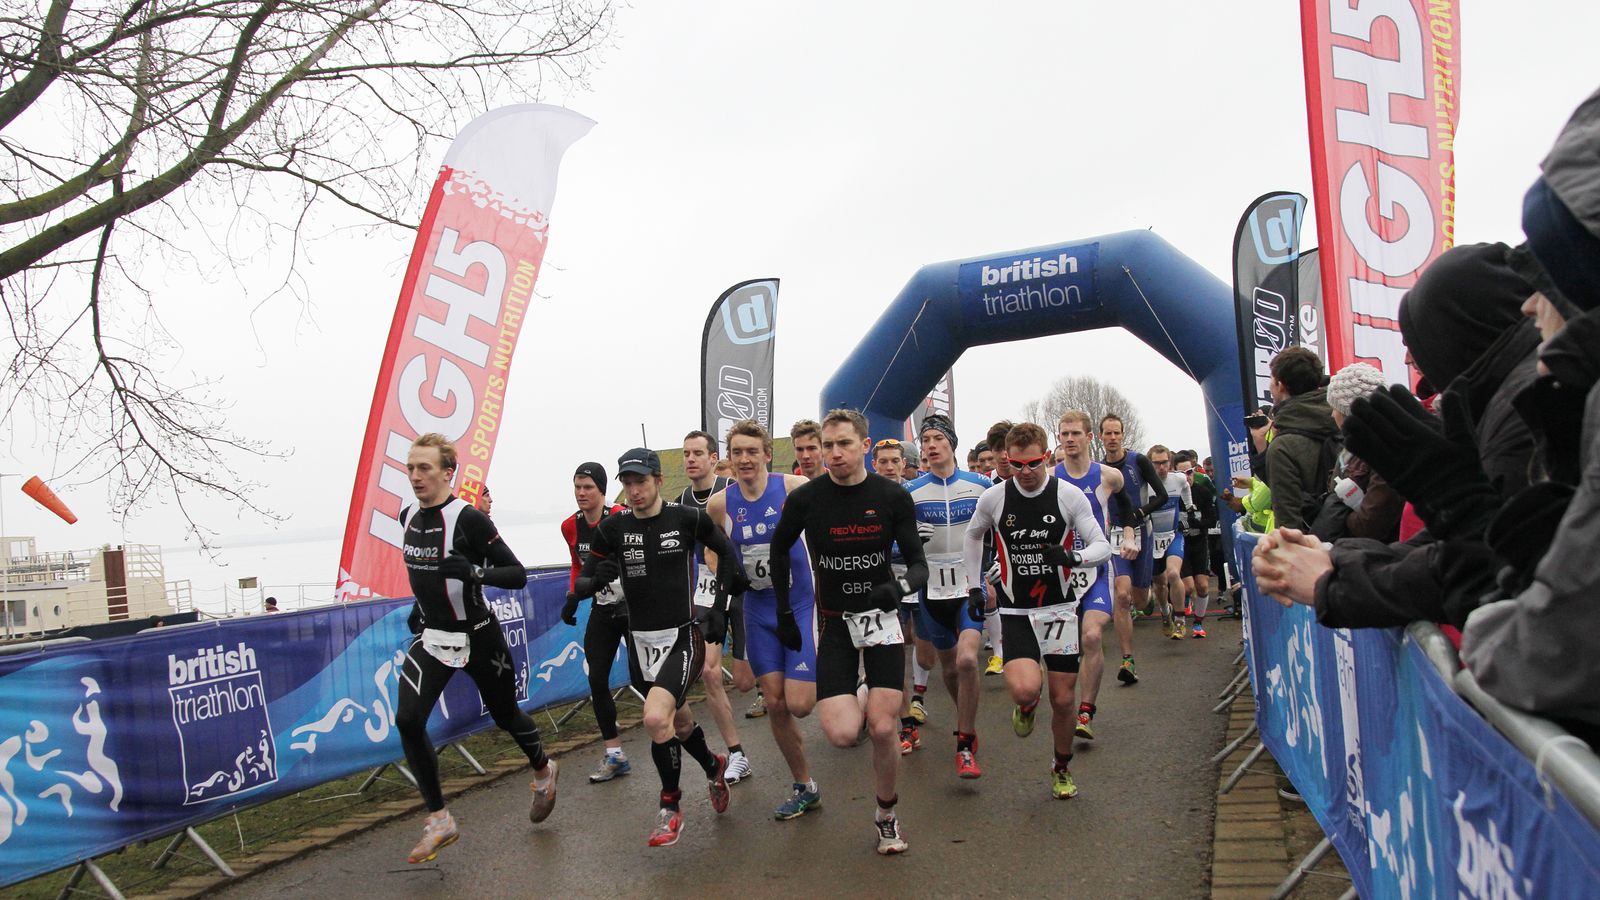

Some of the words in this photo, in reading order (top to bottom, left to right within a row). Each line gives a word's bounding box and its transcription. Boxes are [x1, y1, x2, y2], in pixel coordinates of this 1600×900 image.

[981, 253, 1078, 286] british
[982, 283, 1082, 316] triathlon
[470, 374, 505, 461] SPORTS
[493, 259, 536, 371] NUTRITION
[624, 534, 643, 543] TFN
[819, 549, 885, 571] ANDERSON
[1011, 553, 1044, 565] ROXBUR
[1017, 565, 1053, 576] GBR
[842, 581, 873, 594] GBR
[1043, 619, 1066, 640] 77
[168, 642, 257, 685] british
[176, 681, 264, 724] triathlon
